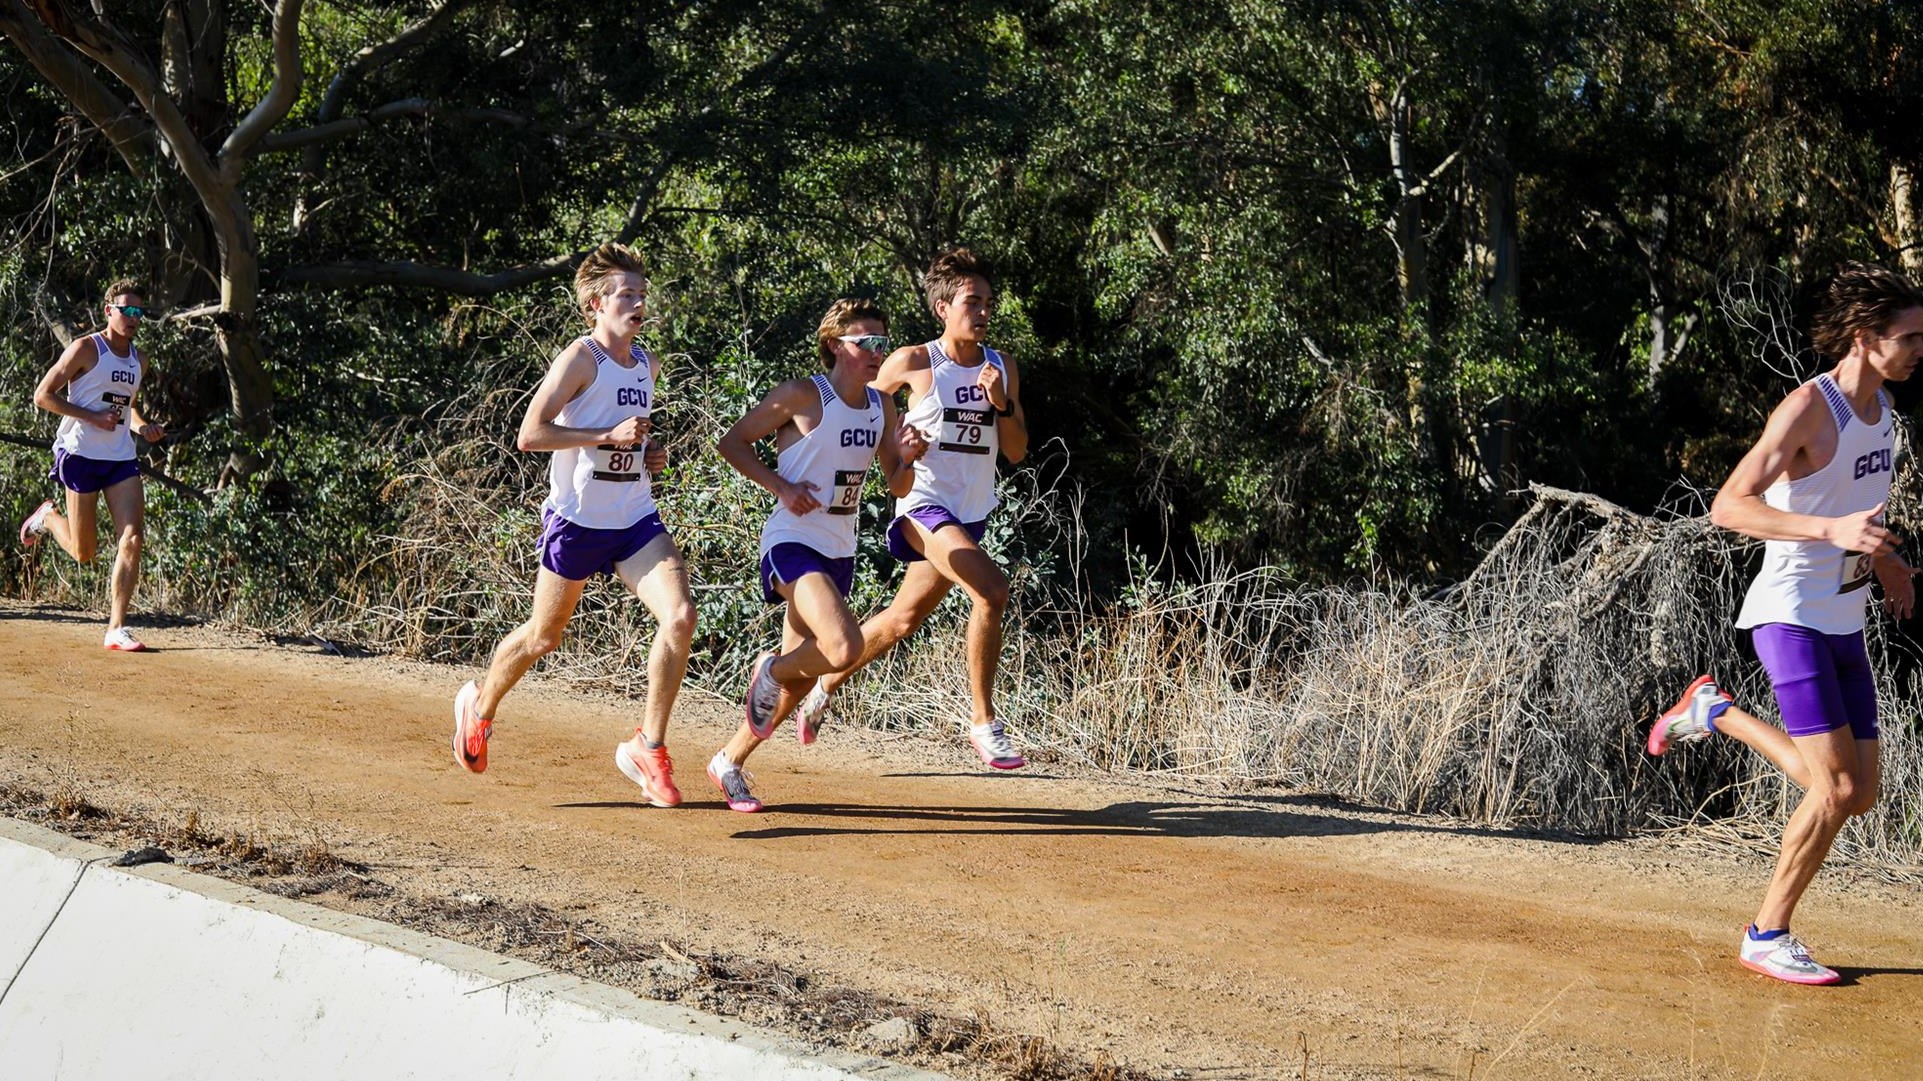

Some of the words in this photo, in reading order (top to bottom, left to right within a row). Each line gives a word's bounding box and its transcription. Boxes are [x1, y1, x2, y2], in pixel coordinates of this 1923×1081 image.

[112, 370, 135, 385] GCU
[617, 388, 648, 408] GCU
[957, 411, 983, 423] WAC
[840, 428, 877, 448] GCU
[955, 424, 982, 444] 79
[608, 452, 634, 472] 80
[1854, 448, 1891, 480] GCU
[842, 487, 860, 506] 84
